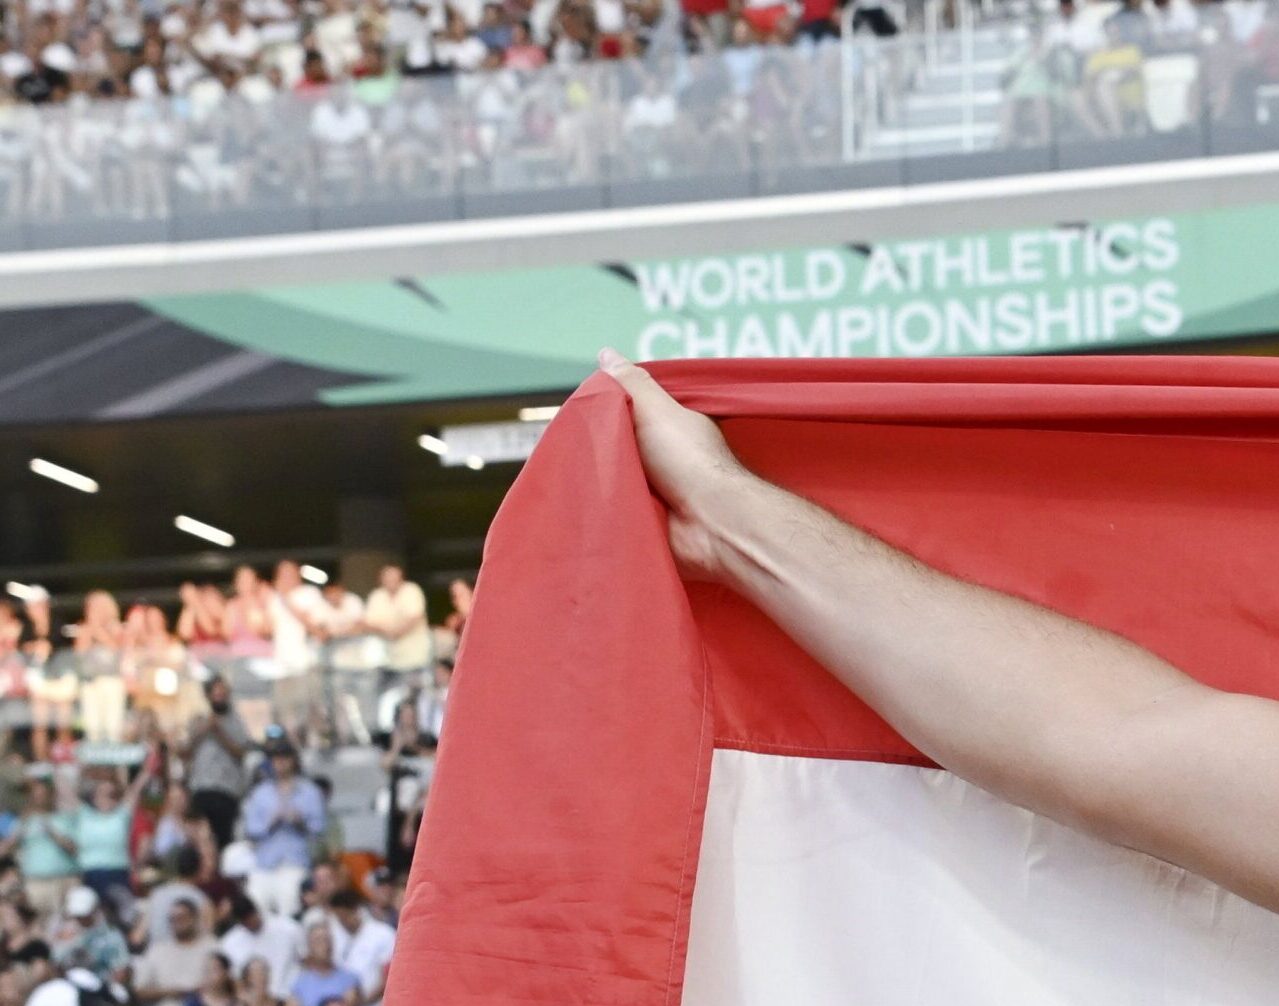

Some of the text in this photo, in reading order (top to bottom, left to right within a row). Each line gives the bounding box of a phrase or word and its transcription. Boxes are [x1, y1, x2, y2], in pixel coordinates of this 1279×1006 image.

[637, 219, 1180, 312] WORLD ATHLETICS
[637, 281, 1183, 363] CHAMPIONSHIPS
